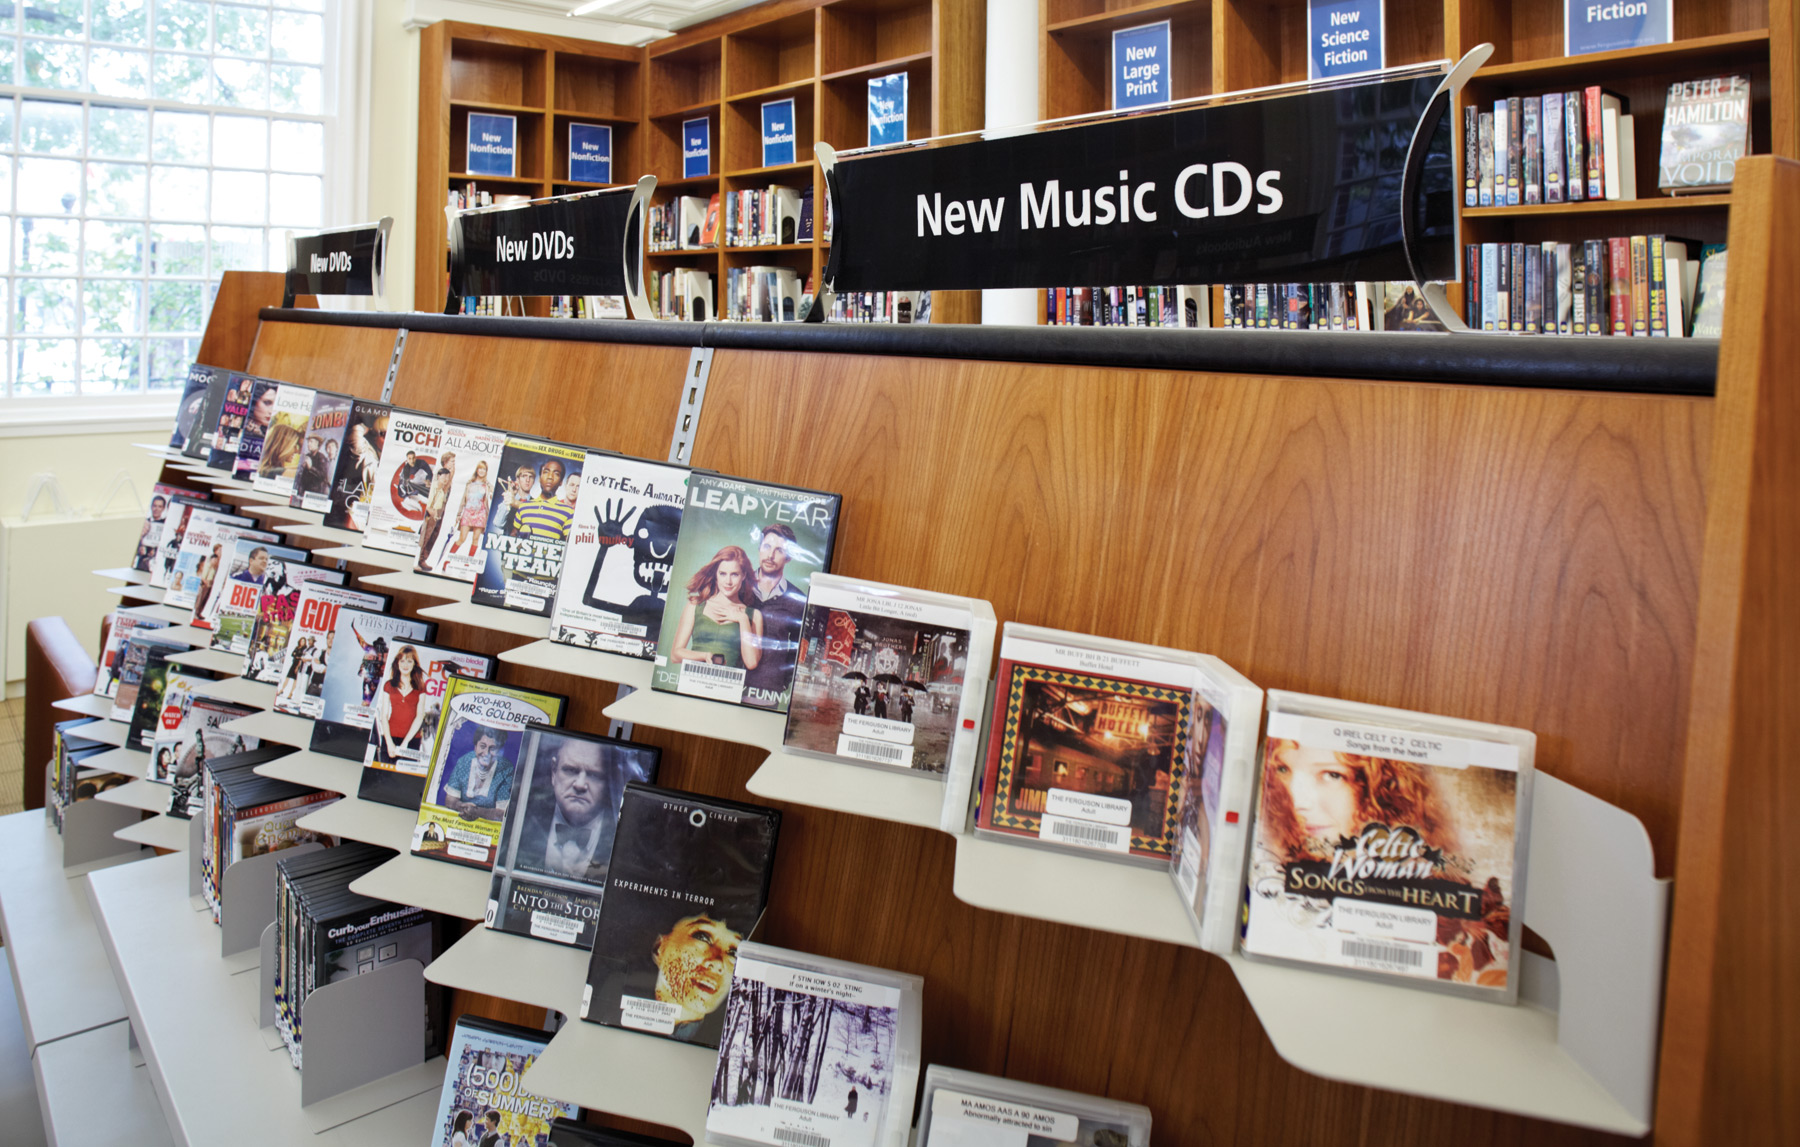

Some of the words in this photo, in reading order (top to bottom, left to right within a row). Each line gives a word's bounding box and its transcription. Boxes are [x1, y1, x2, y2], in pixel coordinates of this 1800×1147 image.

[1330, 10, 1360, 27] New
[1586, 1, 1648, 23] Fiction
[1321, 28, 1370, 48] Science
[1126, 45, 1157, 62] New
[1324, 48, 1368, 67] Fiction
[1123, 63, 1160, 80] Large
[1126, 80, 1158, 97] Print
[1671, 78, 1721, 102] PETER
[1664, 98, 1746, 126] HAMILTON
[771, 121, 785, 131] New
[482, 132, 501, 143] New
[582, 141, 599, 152] New
[690, 138, 701, 147] New
[764, 133, 793, 146] Nonfiction
[470, 143, 513, 155] Nonfiction
[571, 151, 610, 163] Nonfiction
[685, 147, 709, 159] Nonfiction
[1663, 161, 1736, 186] VOID
[916, 192, 1005, 238] New
[1019, 169, 1157, 231] Music
[1174, 161, 1284, 220] CDs
[496, 235, 528, 263] New
[532, 230, 575, 261] DVDs
[310, 252, 328, 273] New
[329, 251, 352, 272] DVDs
[278, 399, 299, 409] Love
[394, 429, 414, 443] TO
[395, 420, 432, 434] CHANDNI
[445, 436, 462, 448] ALL
[463, 440, 501, 455] ABOUT
[699, 478, 717, 487] AMY
[717, 479, 746, 492] ADAMS
[756, 487, 797, 500] MATTHEW
[797, 494, 826, 505] GOODE
[690, 487, 758, 515] LEAP
[760, 498, 829, 529] YEAR
[575, 532, 594, 545] phil
[599, 535, 634, 548] mulloy
[503, 552, 563, 578] TEAM
[230, 584, 258, 611] BIG
[261, 592, 300, 611] PAS
[360, 617, 382, 629] THIS
[384, 622, 393, 631] IS
[395, 624, 405, 633] IT
[465, 656, 484, 666] bledel
[473, 695, 512, 711] YOO-HOO,
[747, 686, 790, 704] FUNNY
[459, 702, 483, 716] MRS.
[859, 719, 889, 729] FERGUSON
[888, 725, 911, 733] LIBRARY
[1098, 717, 1141, 736] HOTEL
[1346, 740, 1371, 751] Songs
[1373, 744, 1391, 753] from
[1393, 746, 1405, 755] the
[1407, 748, 1428, 758] heart
[1364, 732, 1386, 742] CELT
[1410, 739, 1442, 751] CELTIC
[663, 802, 688, 813] OTHER
[709, 812, 738, 823] CINEMA
[1051, 794, 1064, 802] THE
[1065, 796, 1100, 808] FERGUSON
[1101, 803, 1128, 812] LIBRARY
[1356, 828, 1425, 858] Celtic
[1328, 849, 1434, 881] Woman
[517, 885, 543, 895] BRENDAN
[544, 890, 568, 900] GLEESON
[614, 878, 669, 897] EXPERIMENTS
[671, 890, 682, 900] IN
[685, 893, 715, 906] TERROR
[1289, 867, 1365, 896] SONGS
[1402, 887, 1478, 914] HEART
[512, 891, 548, 909] INTO
[550, 902, 563, 911] THE
[1338, 906, 1353, 914] THE
[1355, 908, 1398, 922] FERGUSON
[1399, 915, 1432, 926] LIBRARY
[328, 923, 353, 939] Curb
[353, 922, 370, 934] your
[798, 975, 812, 983] STIN
[844, 983, 863, 993] STING
[810, 985, 834, 995] winter's
[466, 1062, 520, 1097] (500)
[464, 1087, 478, 1098] OF
[476, 1090, 553, 1120] SUMMER
[774, 1102, 784, 1110] THE
[785, 1104, 816, 1116] FERGUSON
[816, 1112, 840, 1121] LIBRARY
[961, 1099, 972, 1108] MA
[974, 1102, 996, 1113] AMOS
[997, 1107, 1013, 1116] AAS
[1021, 1111, 1030, 1119] 90
[1033, 1114, 1055, 1125] AMOS
[963, 1109, 1001, 1124] Abnormally
[1002, 1117, 1033, 1129] attracted
[1033, 1122, 1041, 1131] to
[1041, 1125, 1053, 1133] sin
